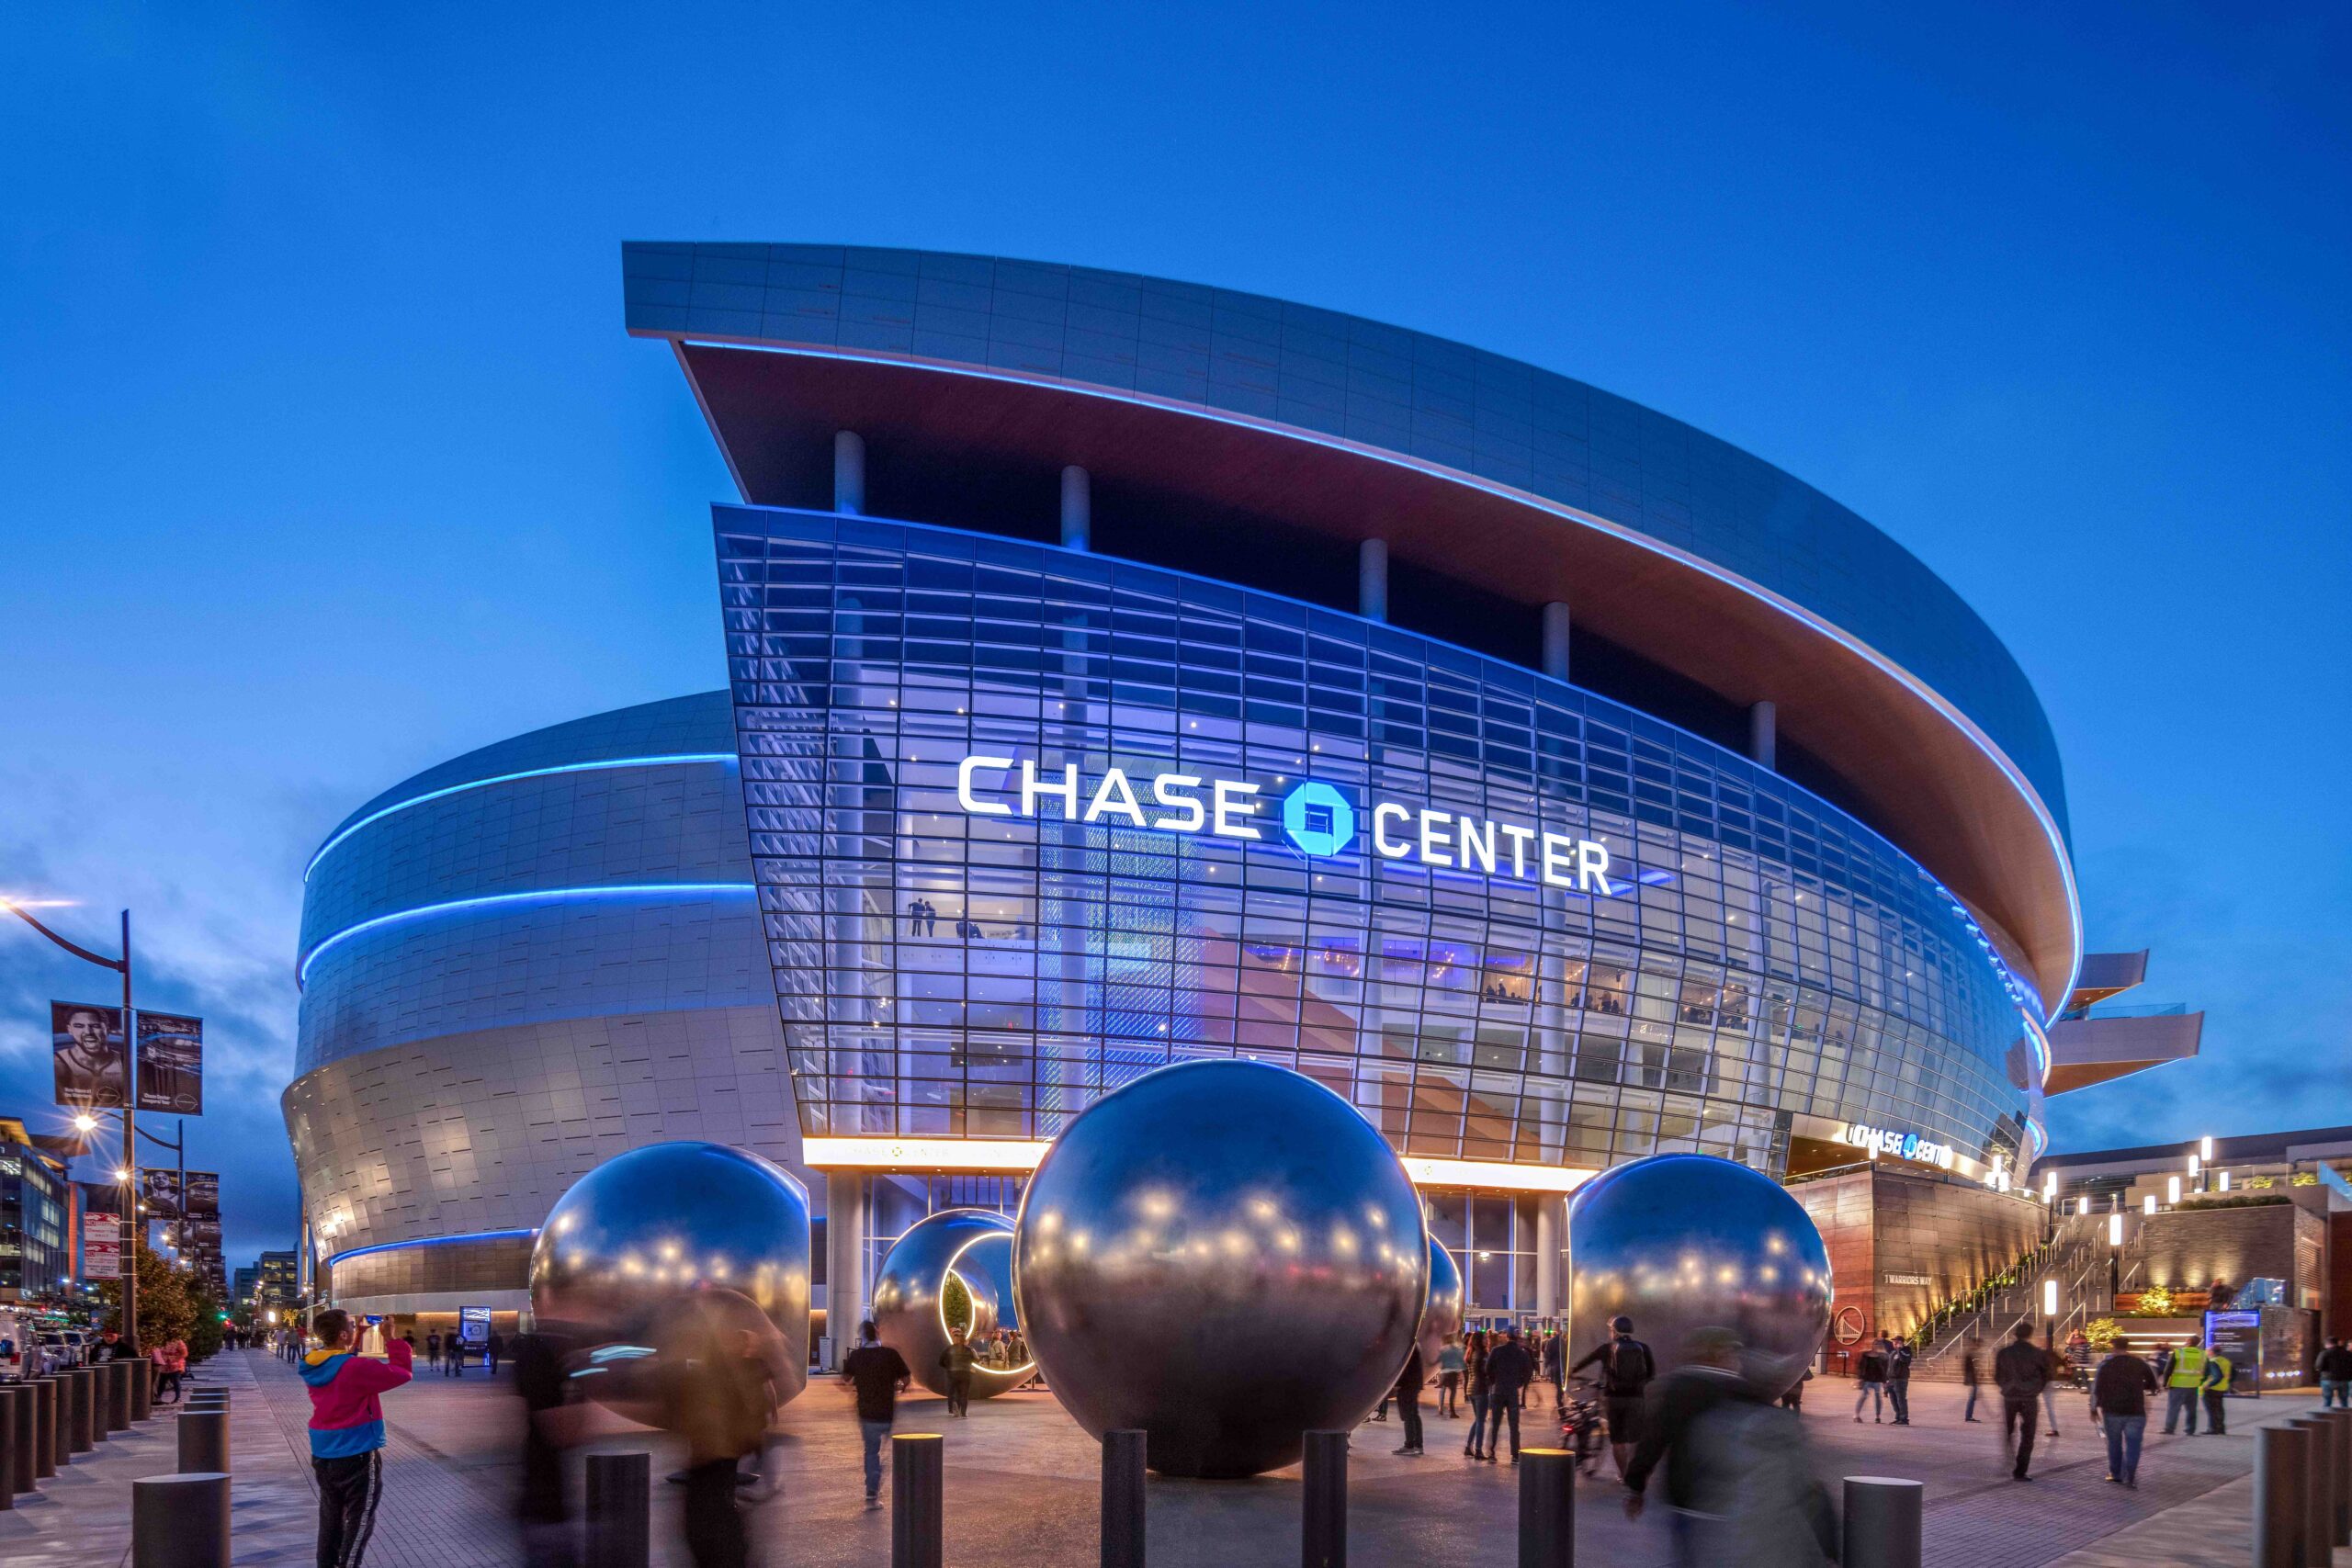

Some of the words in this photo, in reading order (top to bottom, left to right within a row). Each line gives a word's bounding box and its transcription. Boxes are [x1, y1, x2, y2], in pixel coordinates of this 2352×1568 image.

[957, 755, 1262, 840] CHASE
[1374, 803, 1612, 897] CENTER
[1889, 1274, 1919, 1285] WARRIORS
[1919, 1276, 1932, 1286] WAY
